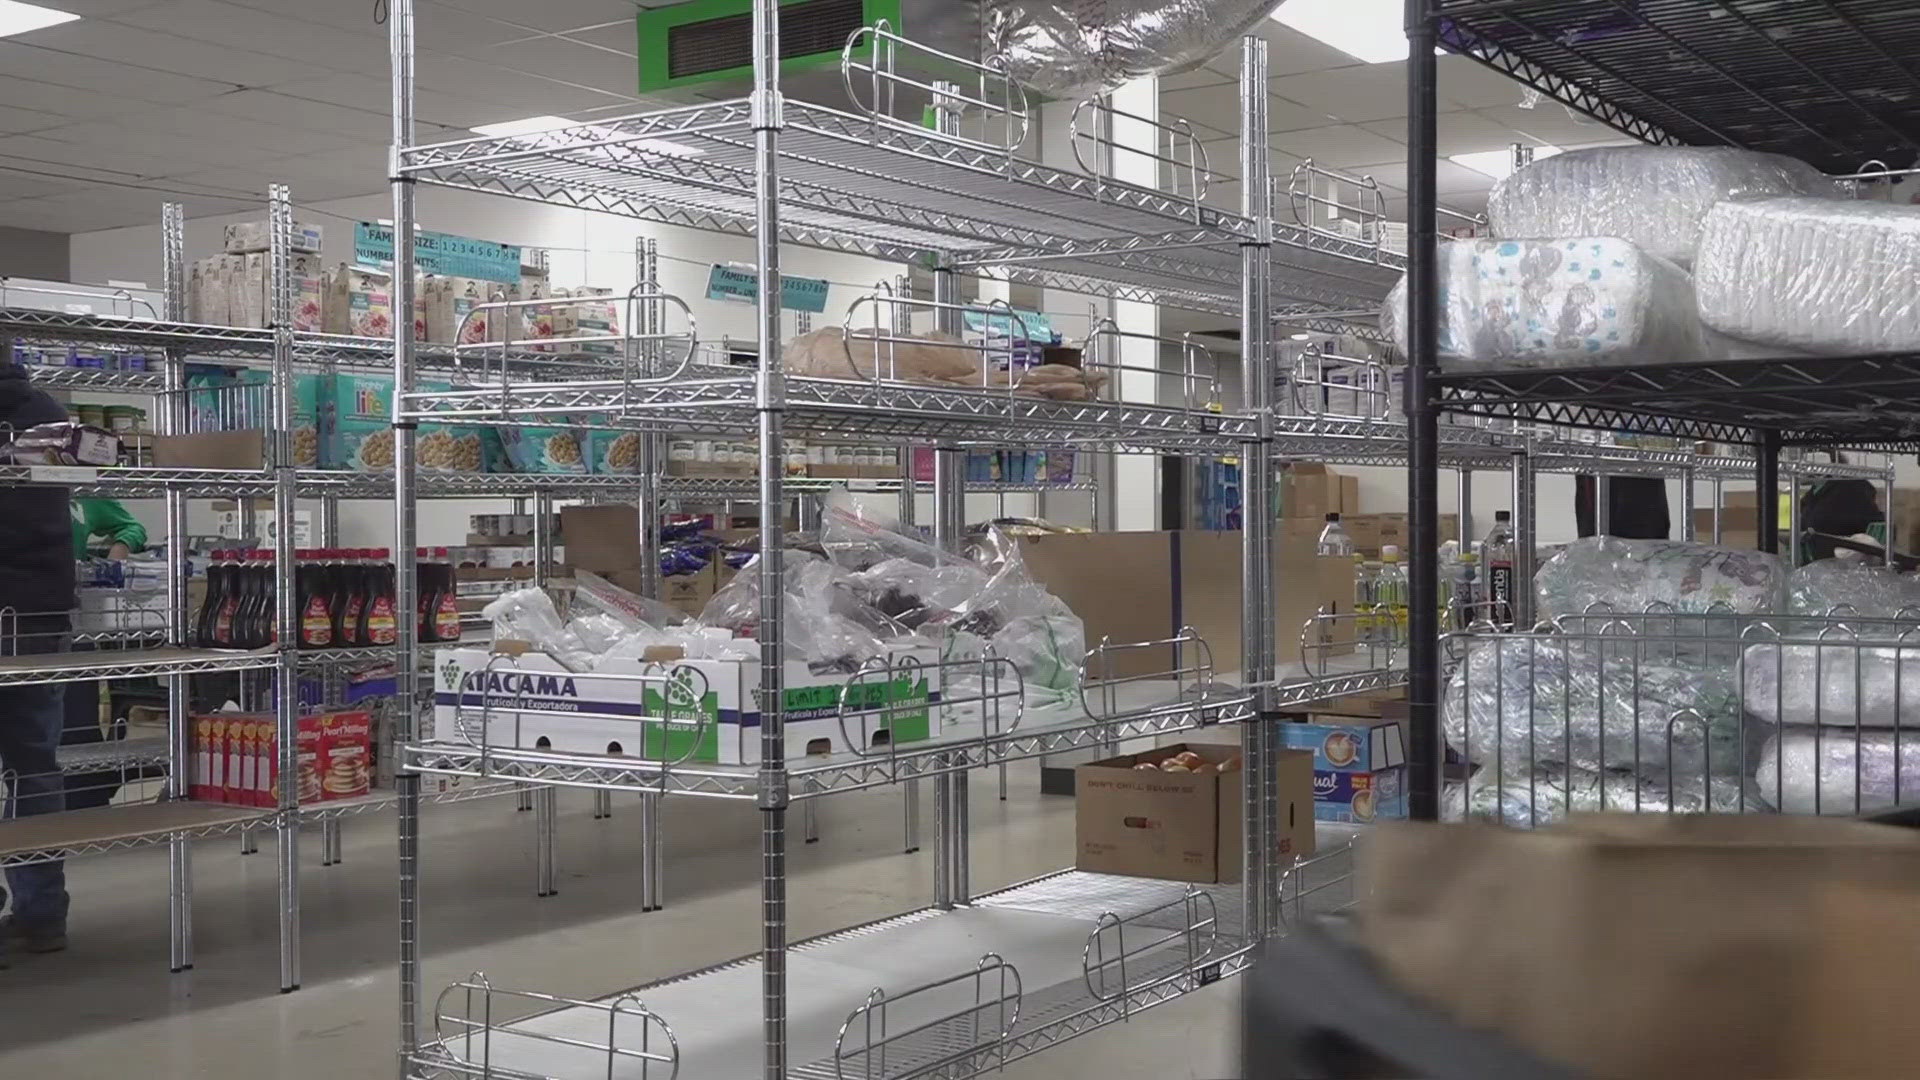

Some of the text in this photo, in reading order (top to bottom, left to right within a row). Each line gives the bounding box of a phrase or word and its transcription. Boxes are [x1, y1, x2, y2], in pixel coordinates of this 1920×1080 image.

[369, 230, 393, 242] FAM
[442, 241, 448, 251] 1
[451, 243, 457, 252] 2
[460, 244, 466, 253] 3
[469, 246, 475, 254] 4
[478, 247, 484, 256] 5
[487, 248, 493, 257] 6
[495, 249, 501, 258] 7
[414, 256, 438, 268] NITS:
[355, 389, 385, 417] life
[464, 671, 578, 697] ATACAMA
[527, 699, 578, 712] Exportadora
[1313, 773, 1339, 788] ual
